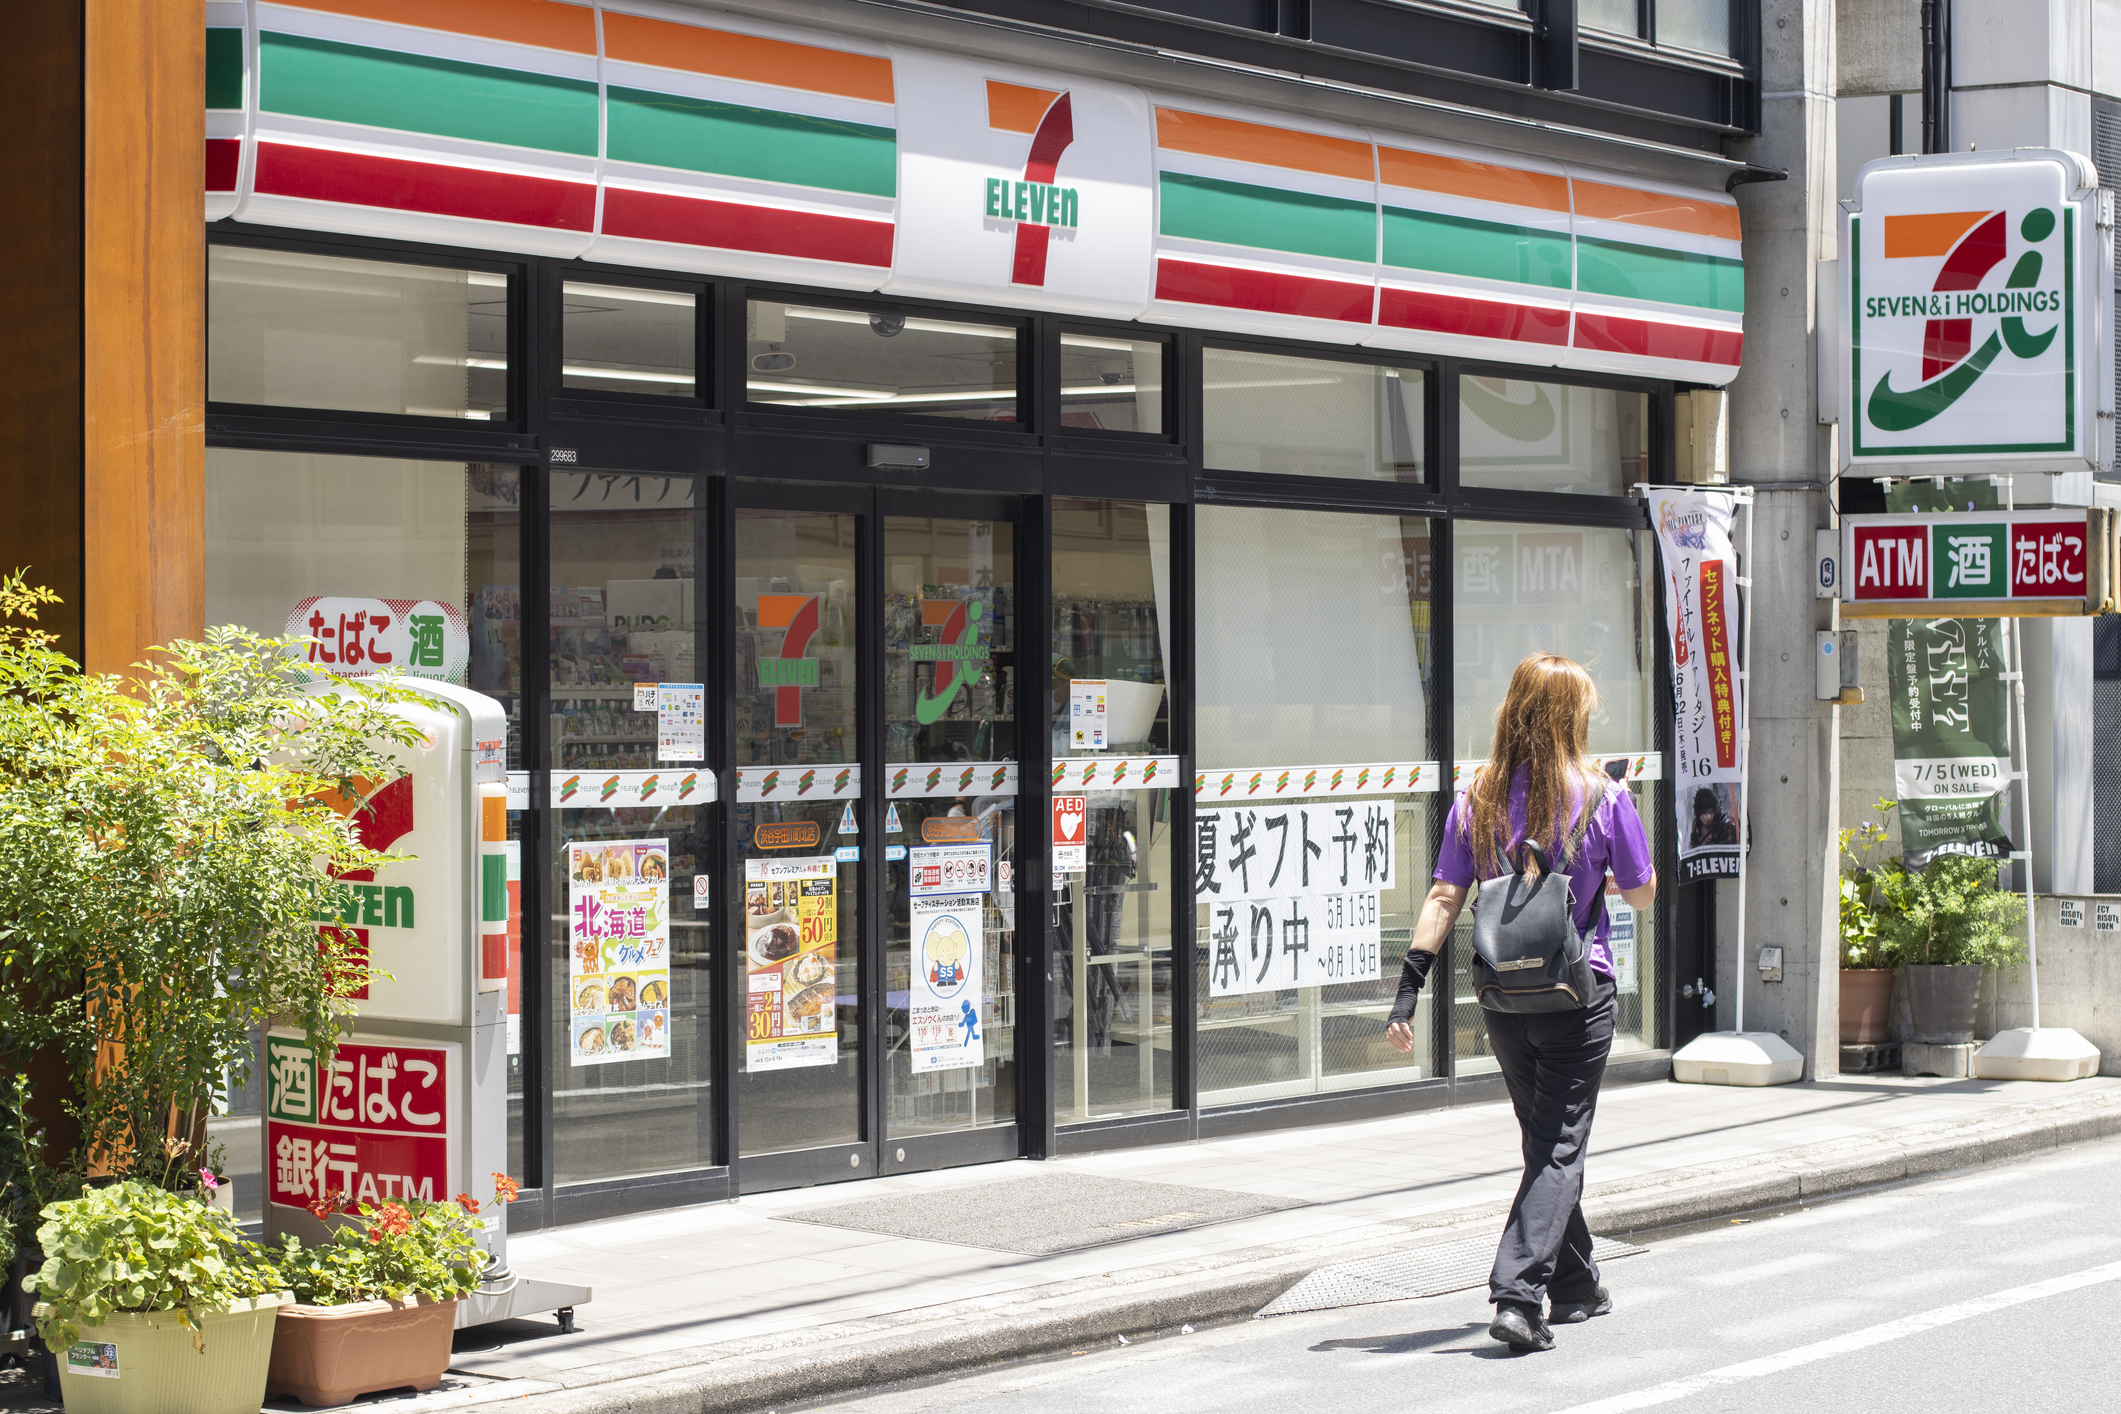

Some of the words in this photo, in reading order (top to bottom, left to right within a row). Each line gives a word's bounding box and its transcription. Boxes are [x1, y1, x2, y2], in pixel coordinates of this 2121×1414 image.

[1957, 289, 2060, 316] HOLDINGS
[550, 449, 577, 463] 299683
[1859, 538, 1924, 587] ATM
[1947, 535, 1993, 589] 酒
[2015, 531, 2084, 586] たばこ
[308, 609, 393, 666] たばこ
[408, 613, 445, 667] 酒
[948, 645, 990, 661] HOLDINGS
[1055, 798, 1084, 812] AED
[1934, 783, 1950, 794] ON
[1952, 782, 1980, 794] SALE
[1196, 804, 1390, 895] 夏ギフト予約
[1919, 826, 1960, 837] TOMORROW
[574, 894, 647, 941] 北海道
[1327, 894, 1376, 930] 5月15日
[618, 944, 645, 965] グルメ
[643, 937, 665, 957] フェア
[1211, 900, 1310, 990] 承り中
[932, 1026, 941, 1035] 119
[270, 1042, 313, 1117] 酒
[321, 1051, 441, 1126] たばこ
[276, 1135, 359, 1199] 銀行
[358, 1172, 433, 1205] ATM
